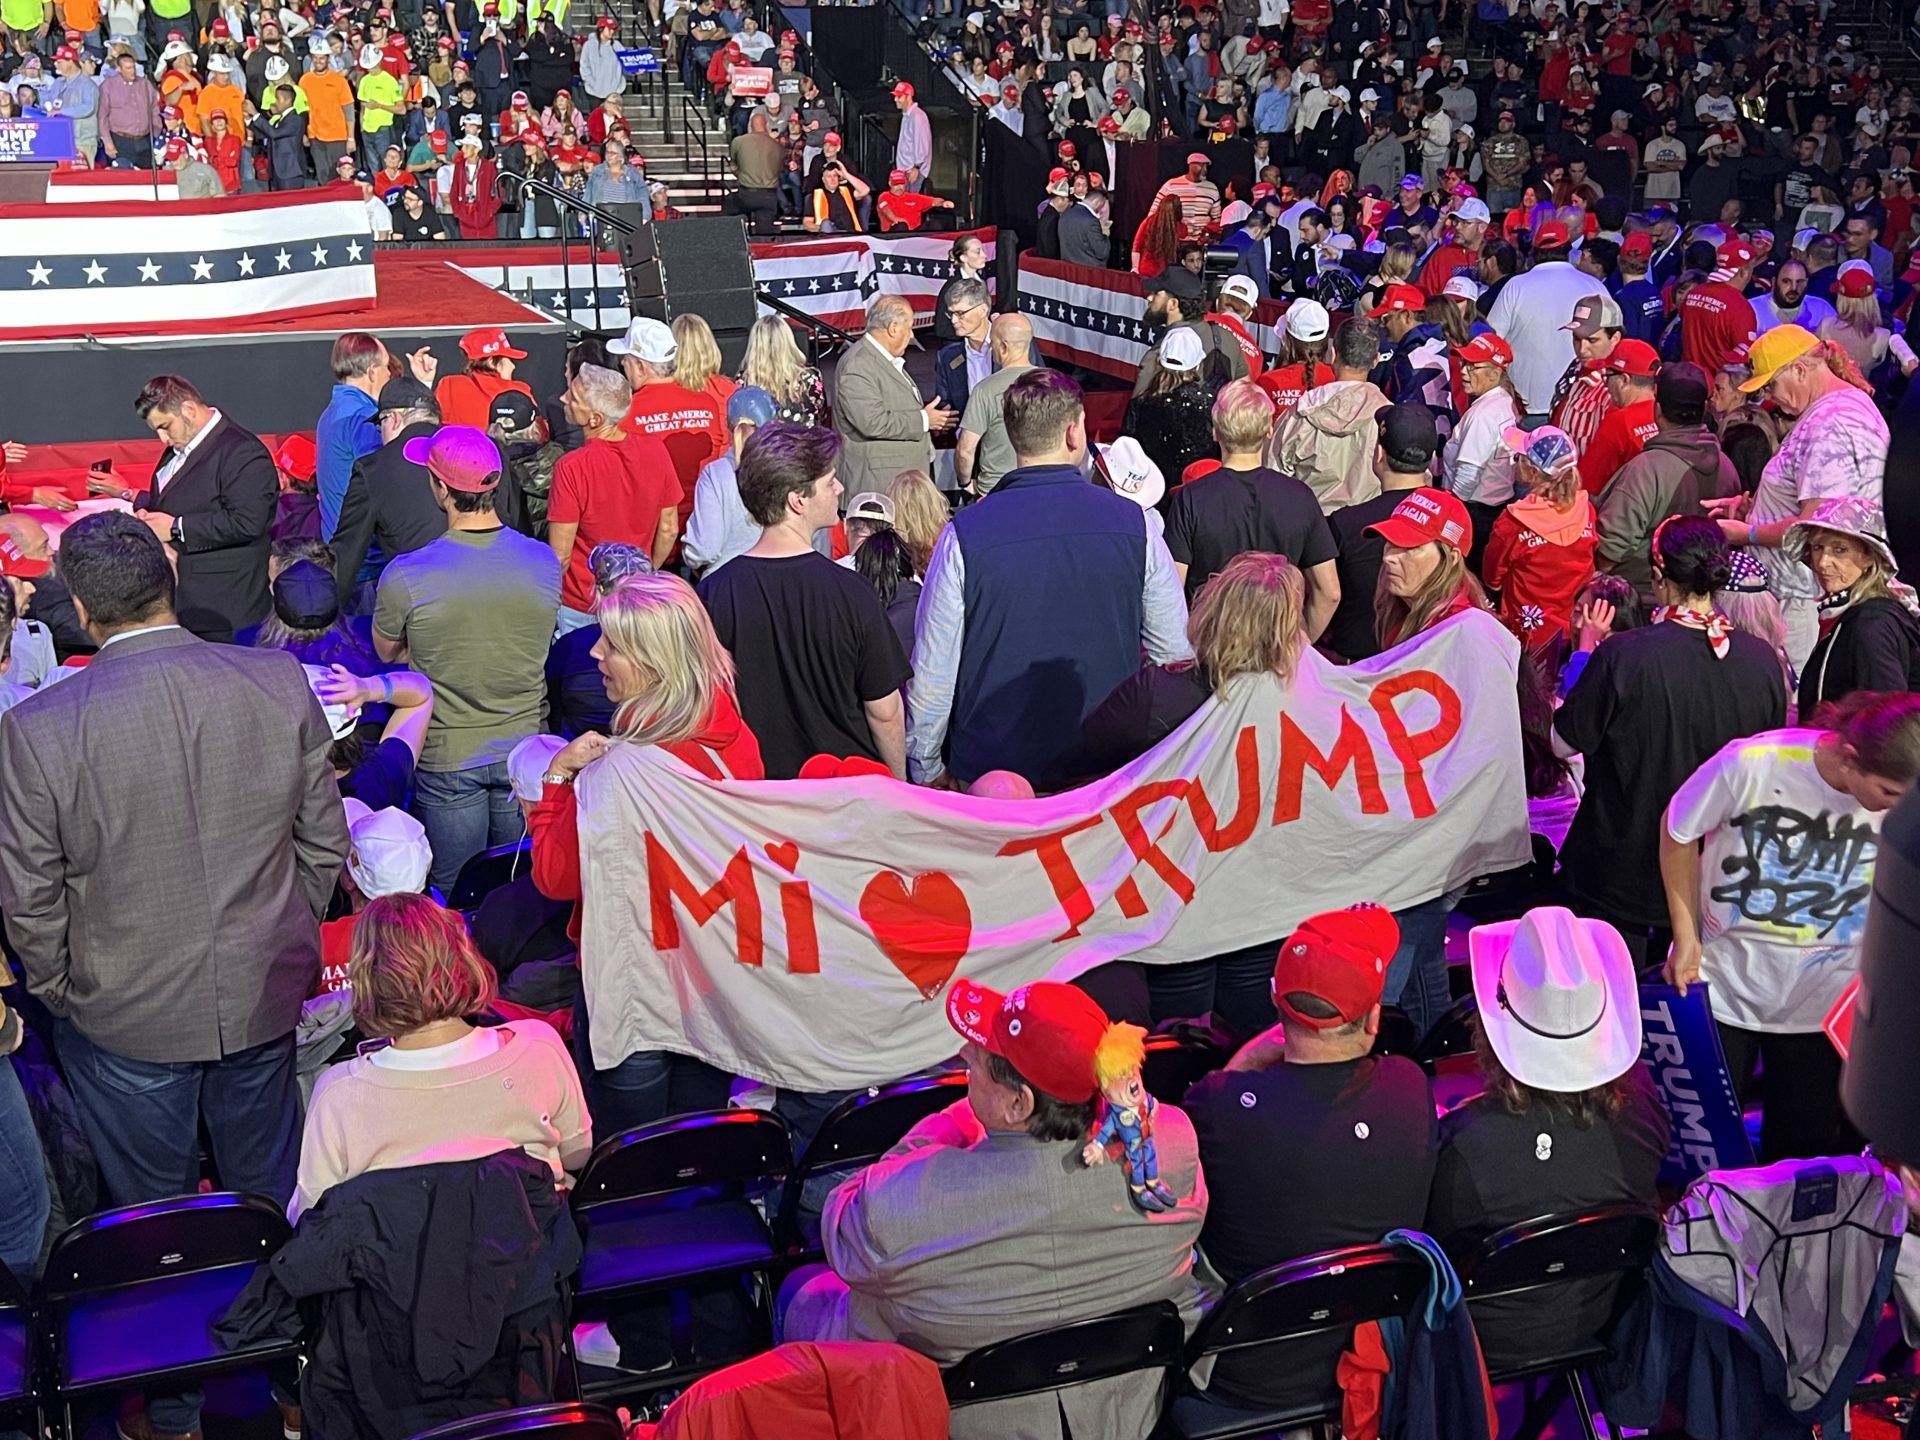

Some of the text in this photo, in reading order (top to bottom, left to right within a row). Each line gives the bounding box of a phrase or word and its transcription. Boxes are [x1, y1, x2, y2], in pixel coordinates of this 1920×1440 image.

[620, 53, 654, 63] TRUMP
[1271, 389, 1301, 399] MAKE
[635, 409, 714, 426] MAKE AMERICA
[645, 419, 710, 433] GREAT AGAIN
[1401, 506, 1430, 526] AGAIN
[995, 670, 1462, 943] TRUMP
[1641, 1001, 1719, 1172] TRUMP
